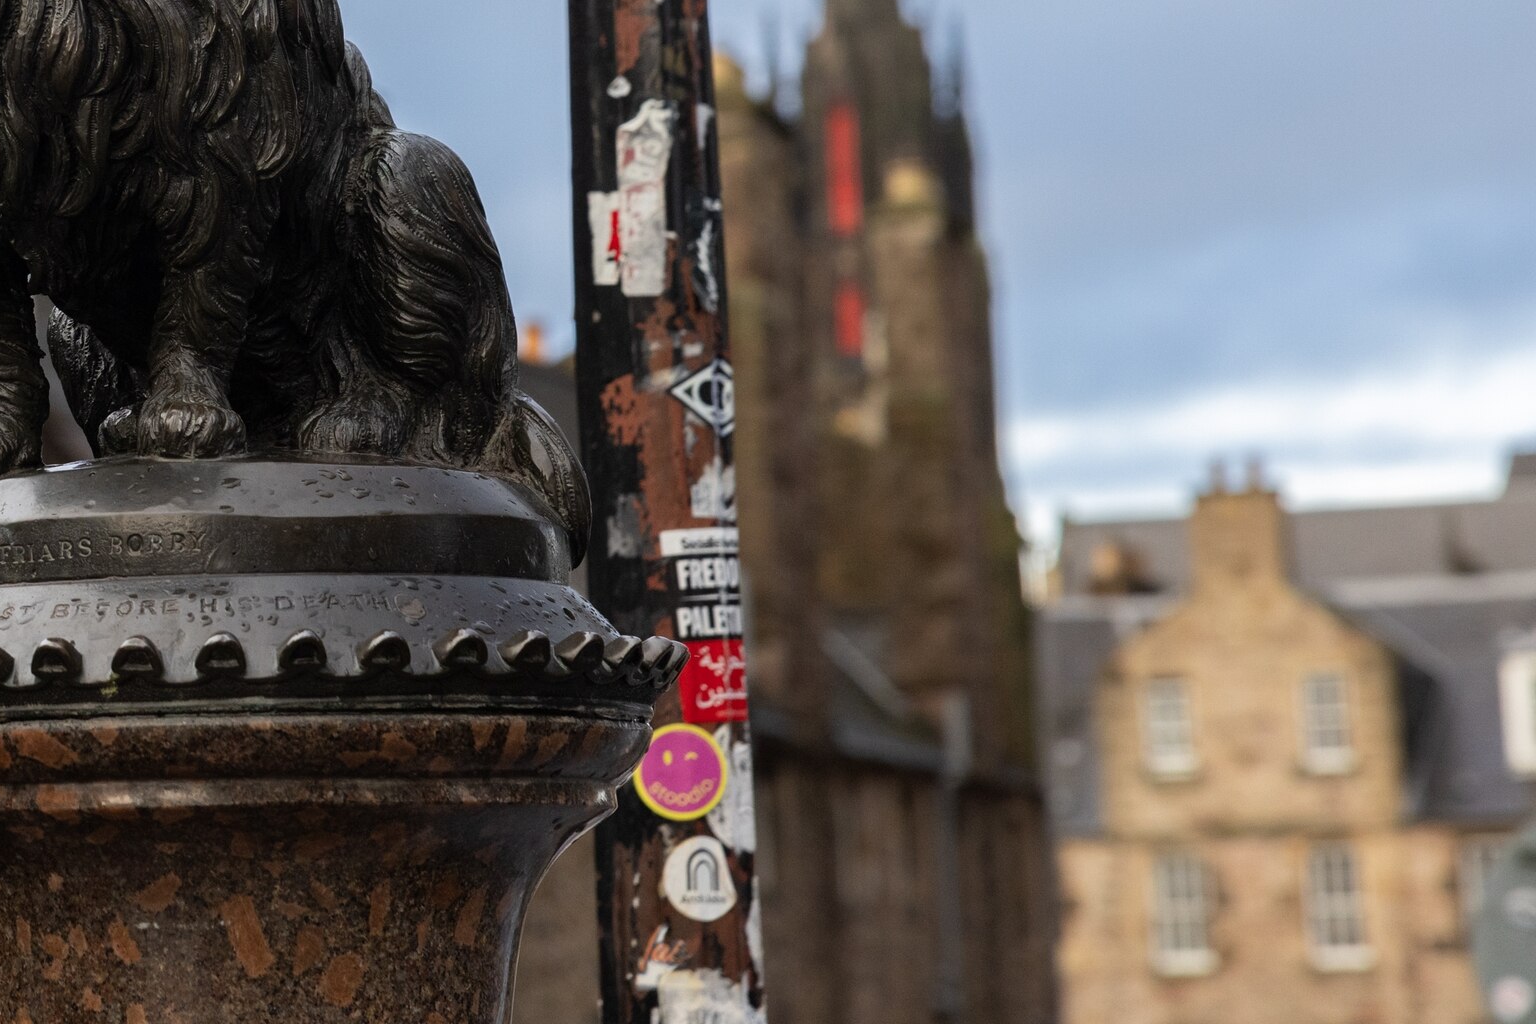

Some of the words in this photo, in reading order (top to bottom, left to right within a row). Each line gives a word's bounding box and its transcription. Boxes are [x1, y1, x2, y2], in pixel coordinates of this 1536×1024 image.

[107, 531, 207, 557] BOBBY
[50, 598, 179, 619] BEFORE
[199, 596, 253, 615] HIS
[275, 593, 390, 611] DEATH
